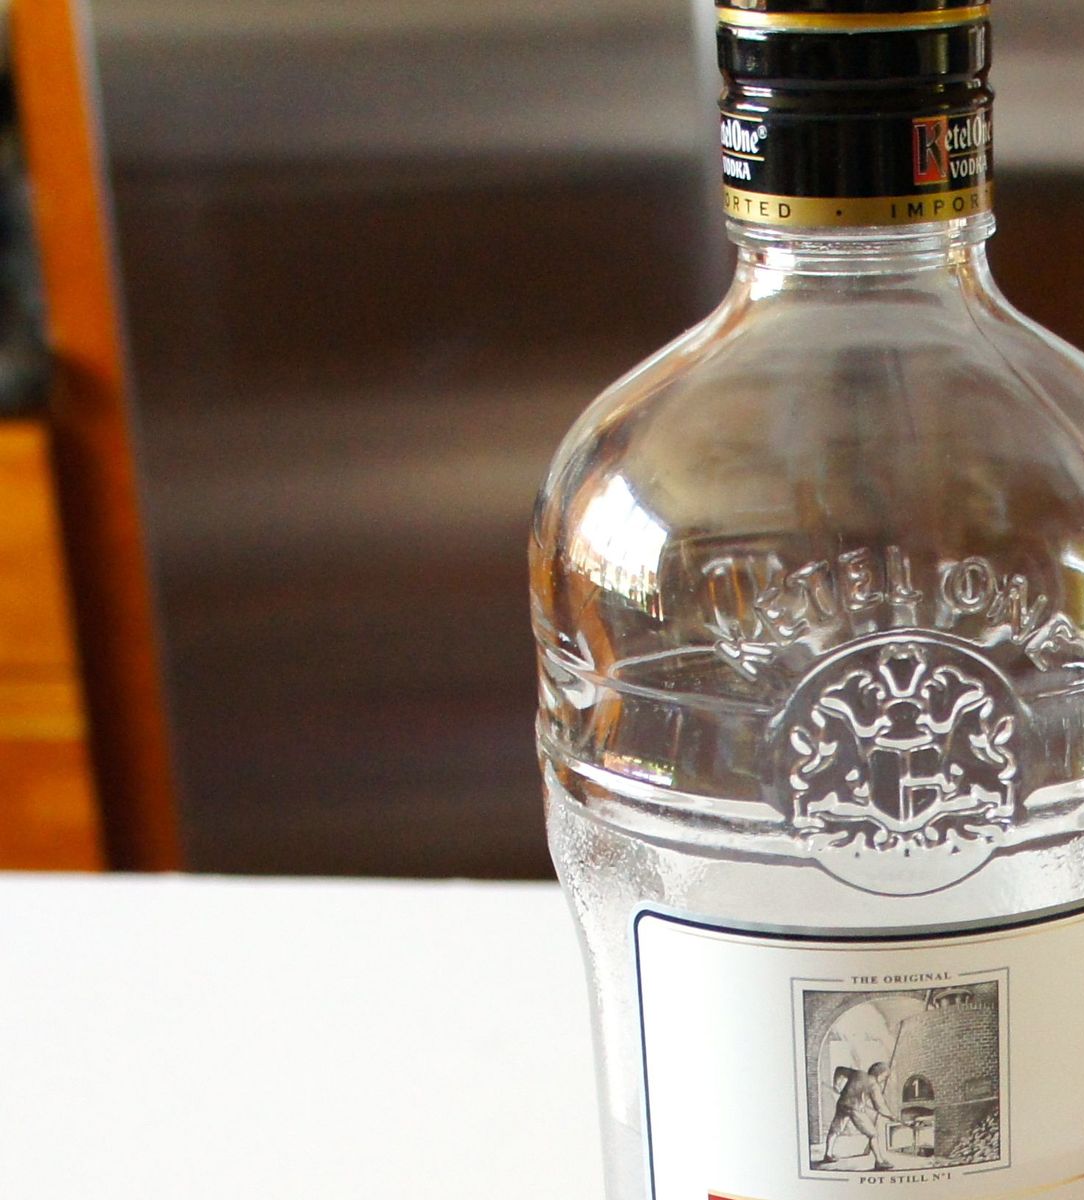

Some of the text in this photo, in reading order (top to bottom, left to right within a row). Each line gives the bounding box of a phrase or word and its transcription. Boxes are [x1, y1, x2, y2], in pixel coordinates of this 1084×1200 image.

[725, 192, 980, 218] ORTED IMPOR
[851, 972, 952, 985] THE ORIGINAL
[860, 1176, 885, 1185] POT
[890, 1175, 929, 1184] STILL
